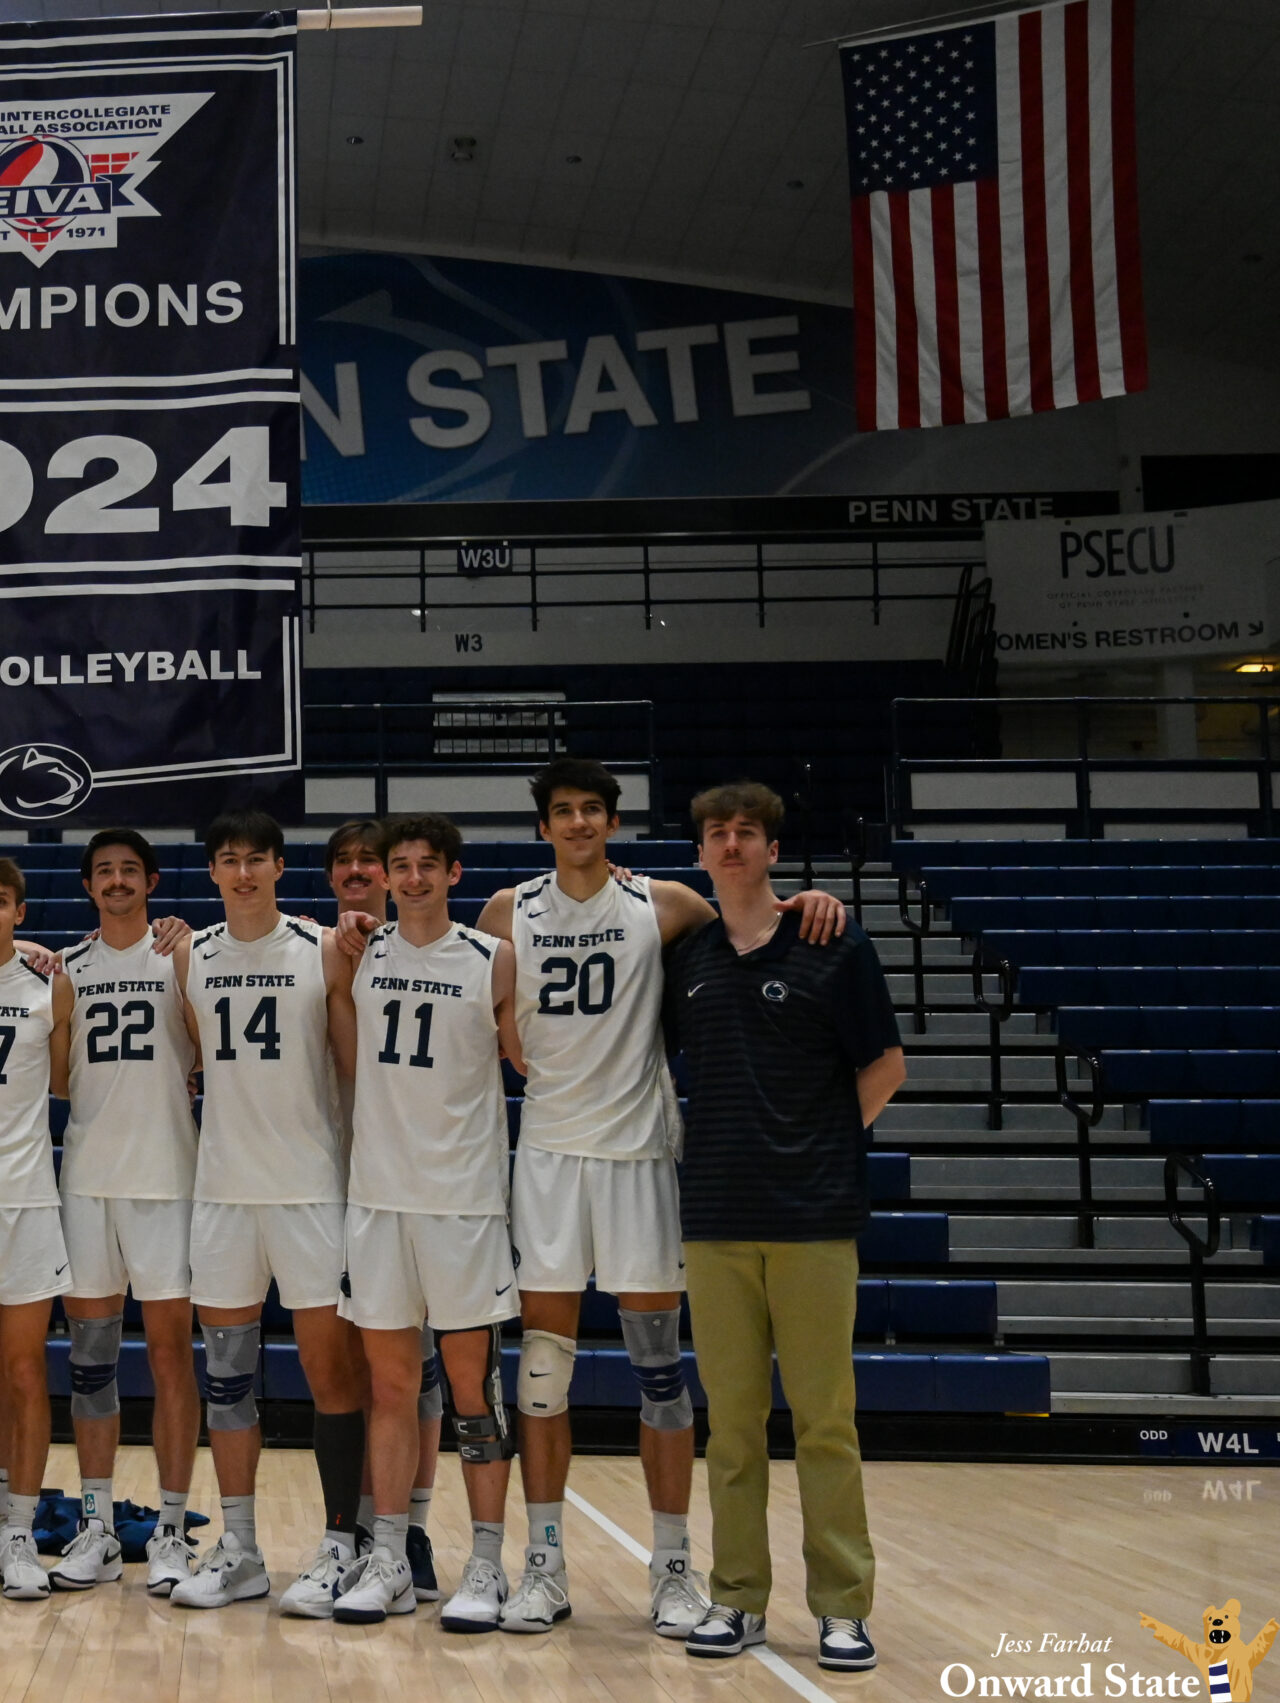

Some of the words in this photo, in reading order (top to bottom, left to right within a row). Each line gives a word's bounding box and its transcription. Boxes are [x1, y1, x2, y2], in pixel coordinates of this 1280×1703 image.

[0, 103, 172, 122] INTERCOLLEGIATE
[33, 117, 163, 135] ASSOCIATION
[66, 226, 106, 239] 1971
[406, 315, 811, 449] STATE
[848, 499, 938, 523] PENN
[951, 497, 1054, 521] STATE
[460, 548, 511, 569] W3U
[1060, 524, 1175, 579] PSECU
[455, 634, 483, 653] W3
[992, 631, 1088, 651] OMEN'S
[1095, 622, 1240, 648] RESTROOM
[532, 934, 576, 948] PENN
[78, 982, 116, 998] PENN
[117, 980, 165, 993] STATE
[204, 975, 244, 989] PENN
[246, 974, 295, 988] STATE
[370, 976, 410, 992] PENN
[411, 979, 462, 998] STATE
[537, 951, 615, 1015] 20
[85, 1000, 155, 1064] 22
[214, 996, 281, 1060] 14
[378, 999, 434, 1069] 11
[1139, 1430, 1168, 1440] ODD
[1197, 1432, 1260, 1454] W4L
